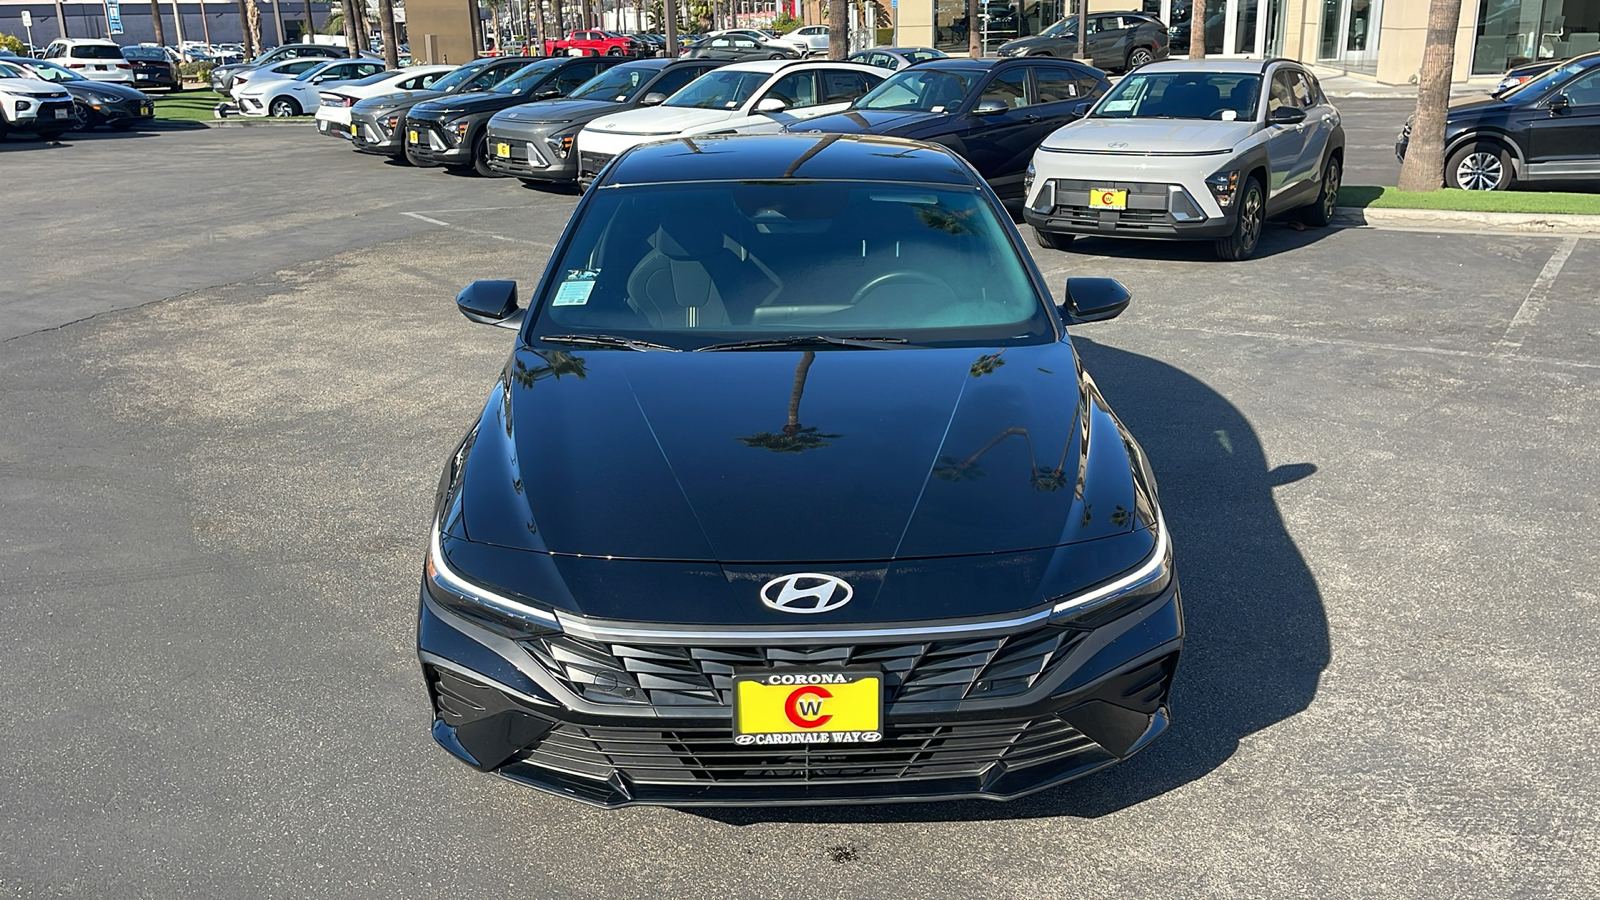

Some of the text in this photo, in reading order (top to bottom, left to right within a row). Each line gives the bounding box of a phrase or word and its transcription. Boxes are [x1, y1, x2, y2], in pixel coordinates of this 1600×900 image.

[768, 673, 847, 684] CORONA
[785, 685, 834, 729] C
[799, 699, 822, 716] W
[756, 732, 862, 744] CARDINALE WAY
